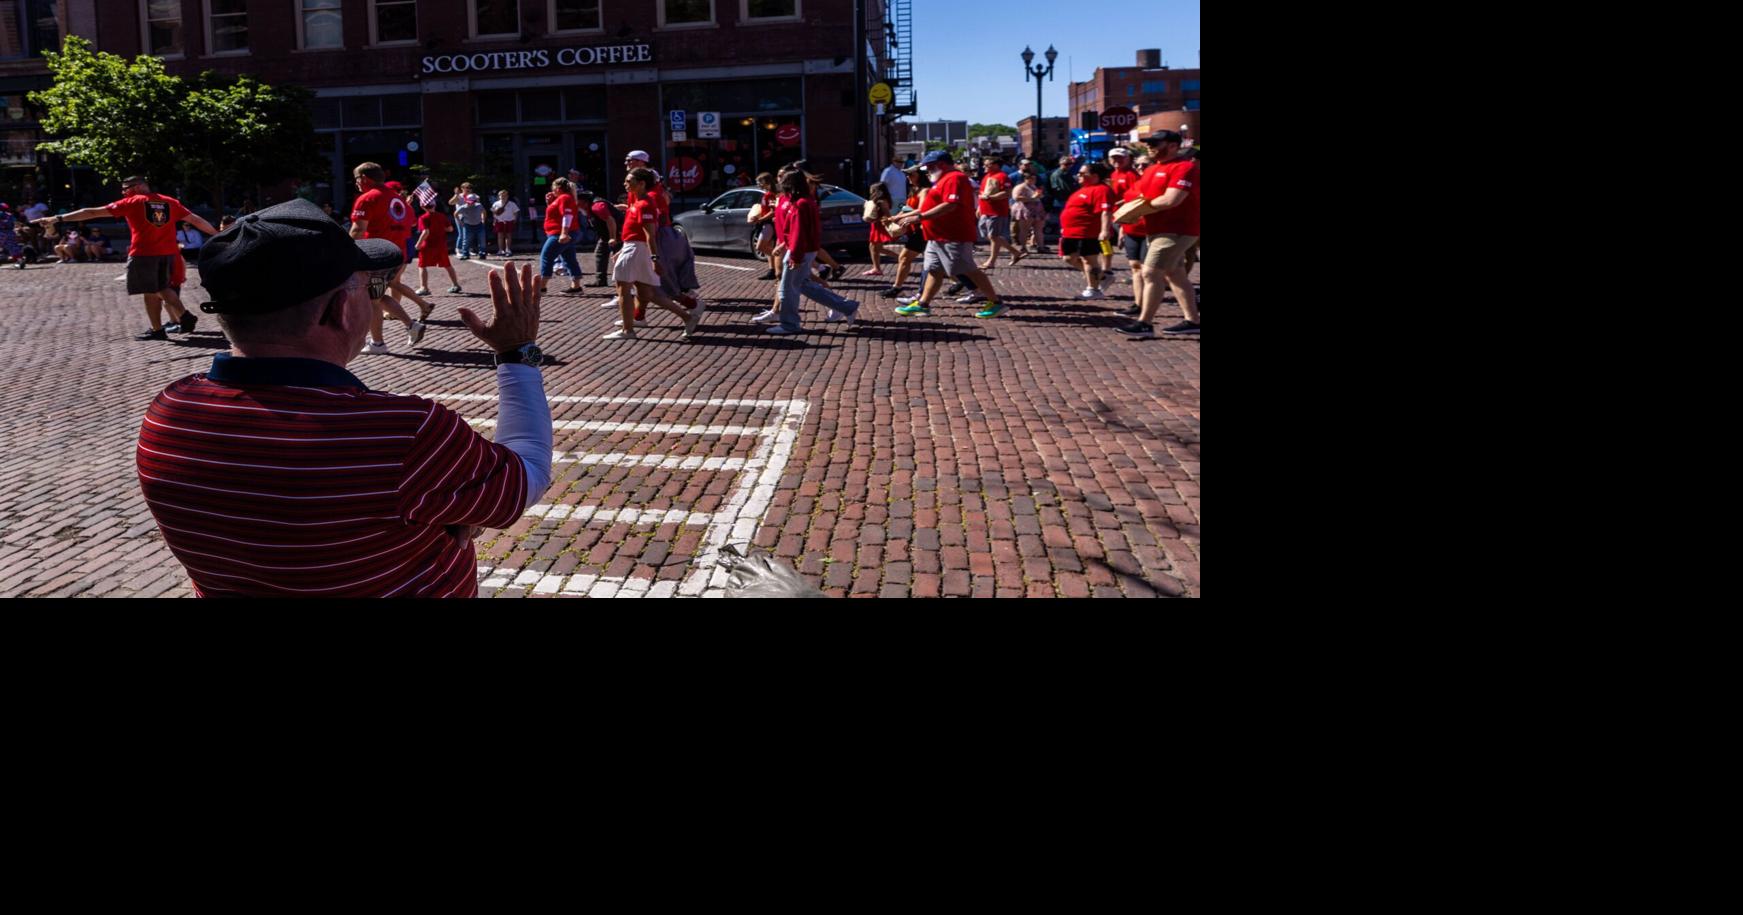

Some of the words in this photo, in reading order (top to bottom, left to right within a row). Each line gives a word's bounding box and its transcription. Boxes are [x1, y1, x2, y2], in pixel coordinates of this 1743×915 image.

[422, 50, 549, 73] SCOOTER'S
[557, 44, 651, 66] COFFEE
[1102, 114, 1135, 126] STOP
[669, 166, 699, 178] knd
